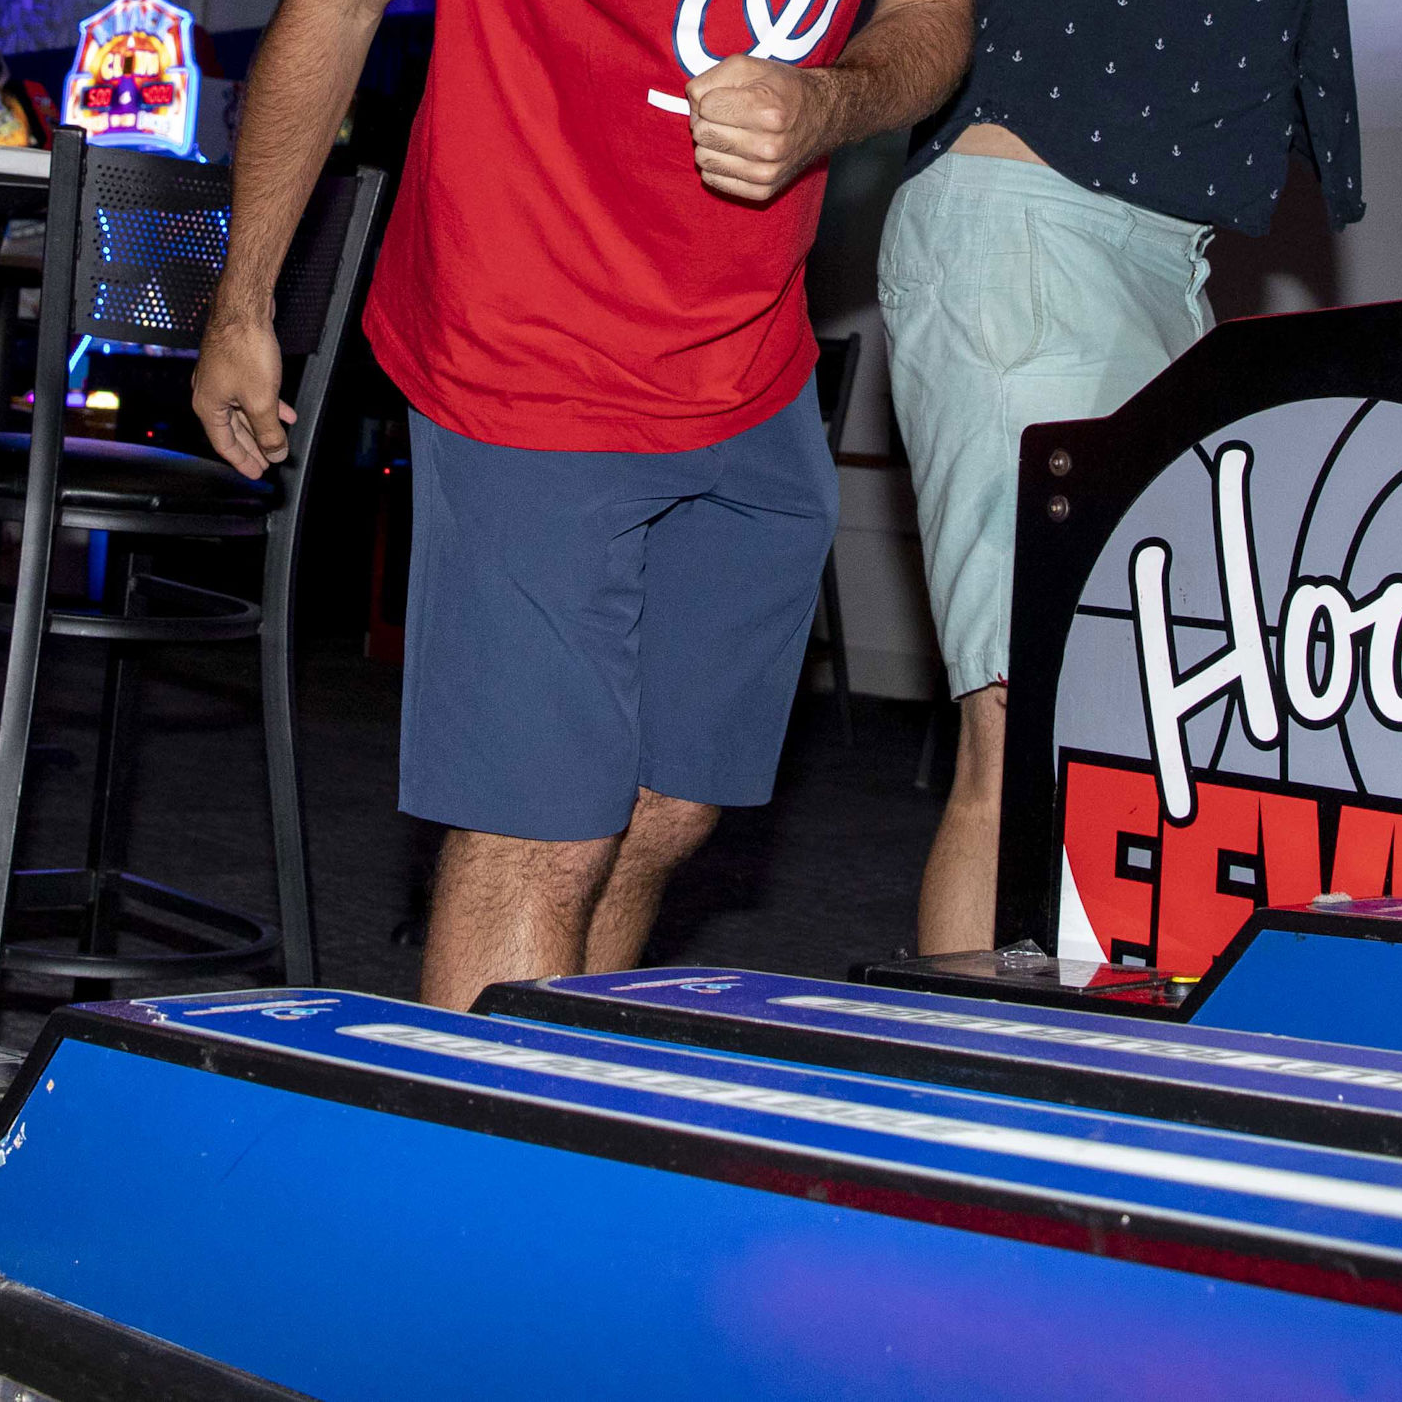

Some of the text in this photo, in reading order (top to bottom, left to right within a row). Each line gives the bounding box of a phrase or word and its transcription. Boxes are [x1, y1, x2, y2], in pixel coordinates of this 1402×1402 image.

[820, 1002, 1018, 1030] LEAGUE
[1018, 1028, 1244, 1060] ROLLER
[370, 1030, 525, 1056] ALLEY
[522, 1055, 719, 1095] ROLLER
